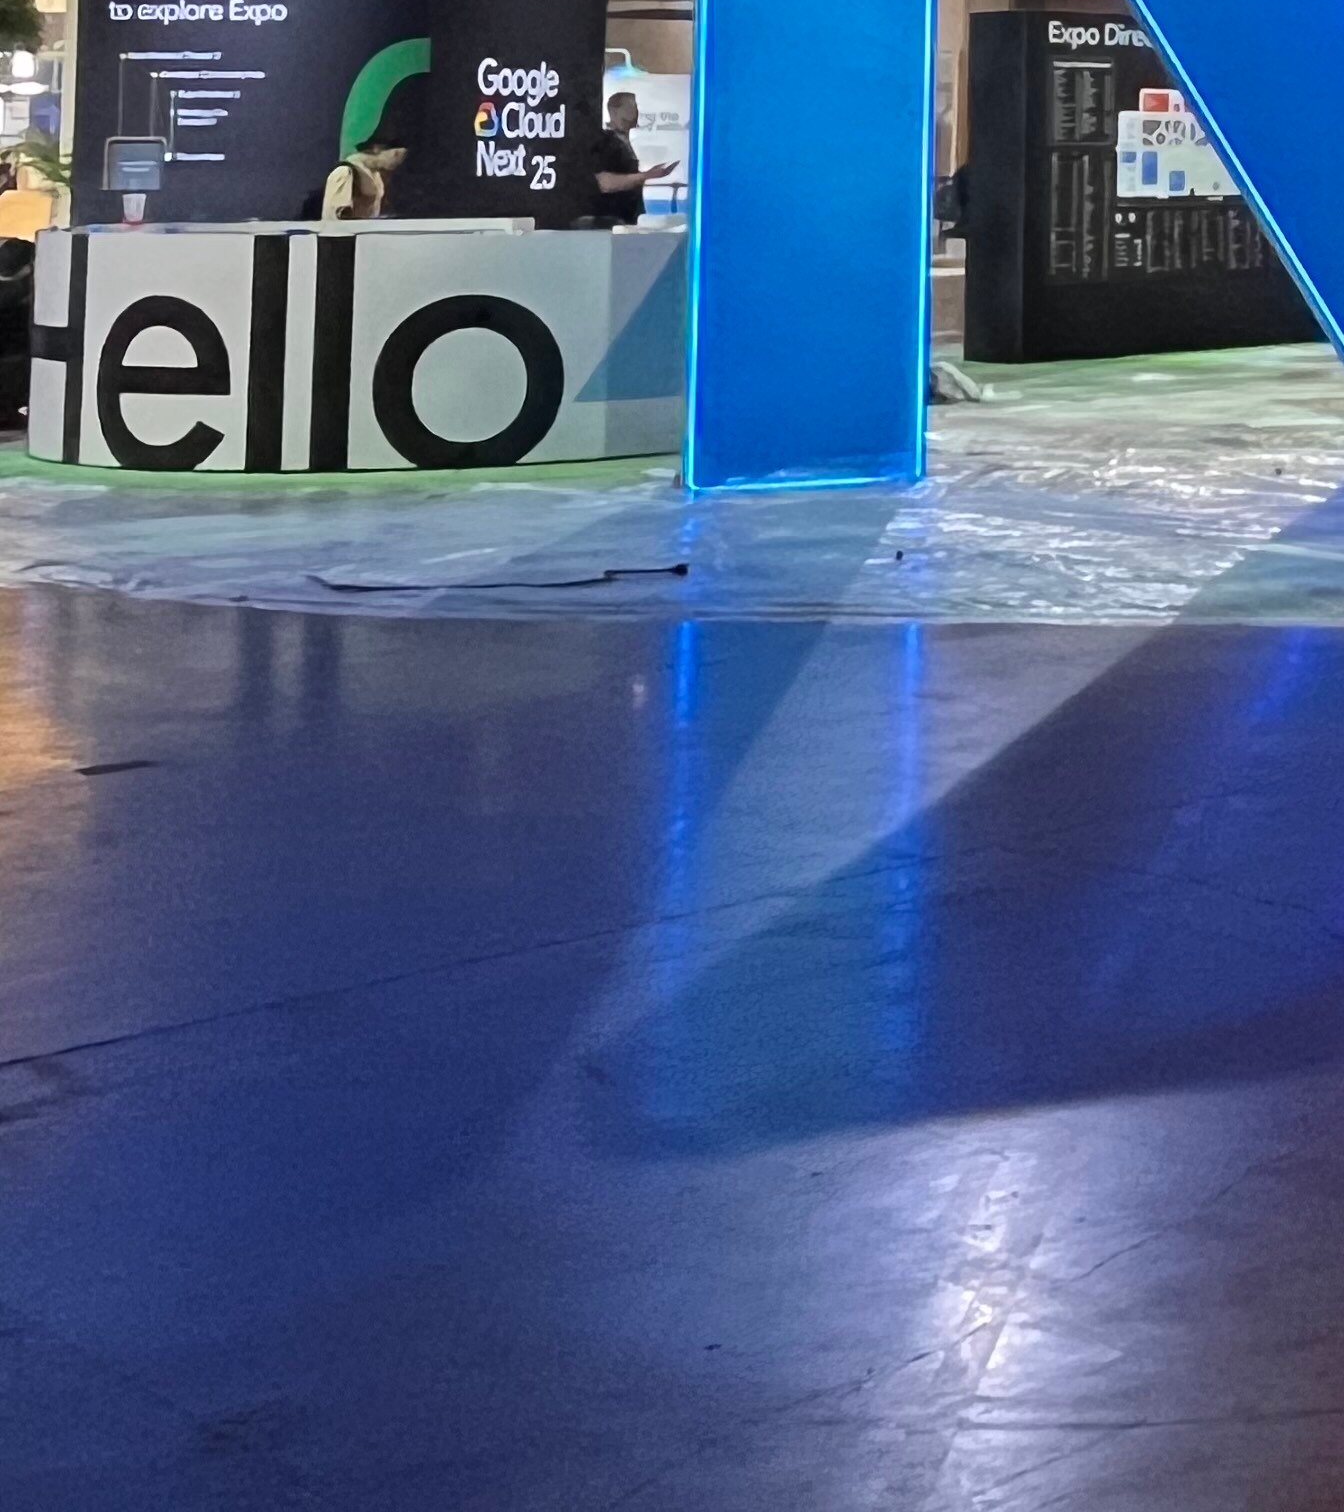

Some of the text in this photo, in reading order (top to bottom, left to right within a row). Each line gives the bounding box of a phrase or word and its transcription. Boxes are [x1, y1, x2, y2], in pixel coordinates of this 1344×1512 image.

[108, 0, 133, 21] to
[137, 0, 224, 26] explore
[1047, 20, 1100, 49] Expo
[477, 57, 560, 106] Google
[501, 101, 566, 139] Cloud
[475, 140, 557, 190] Next 25
[29, 233, 565, 473] Hello
